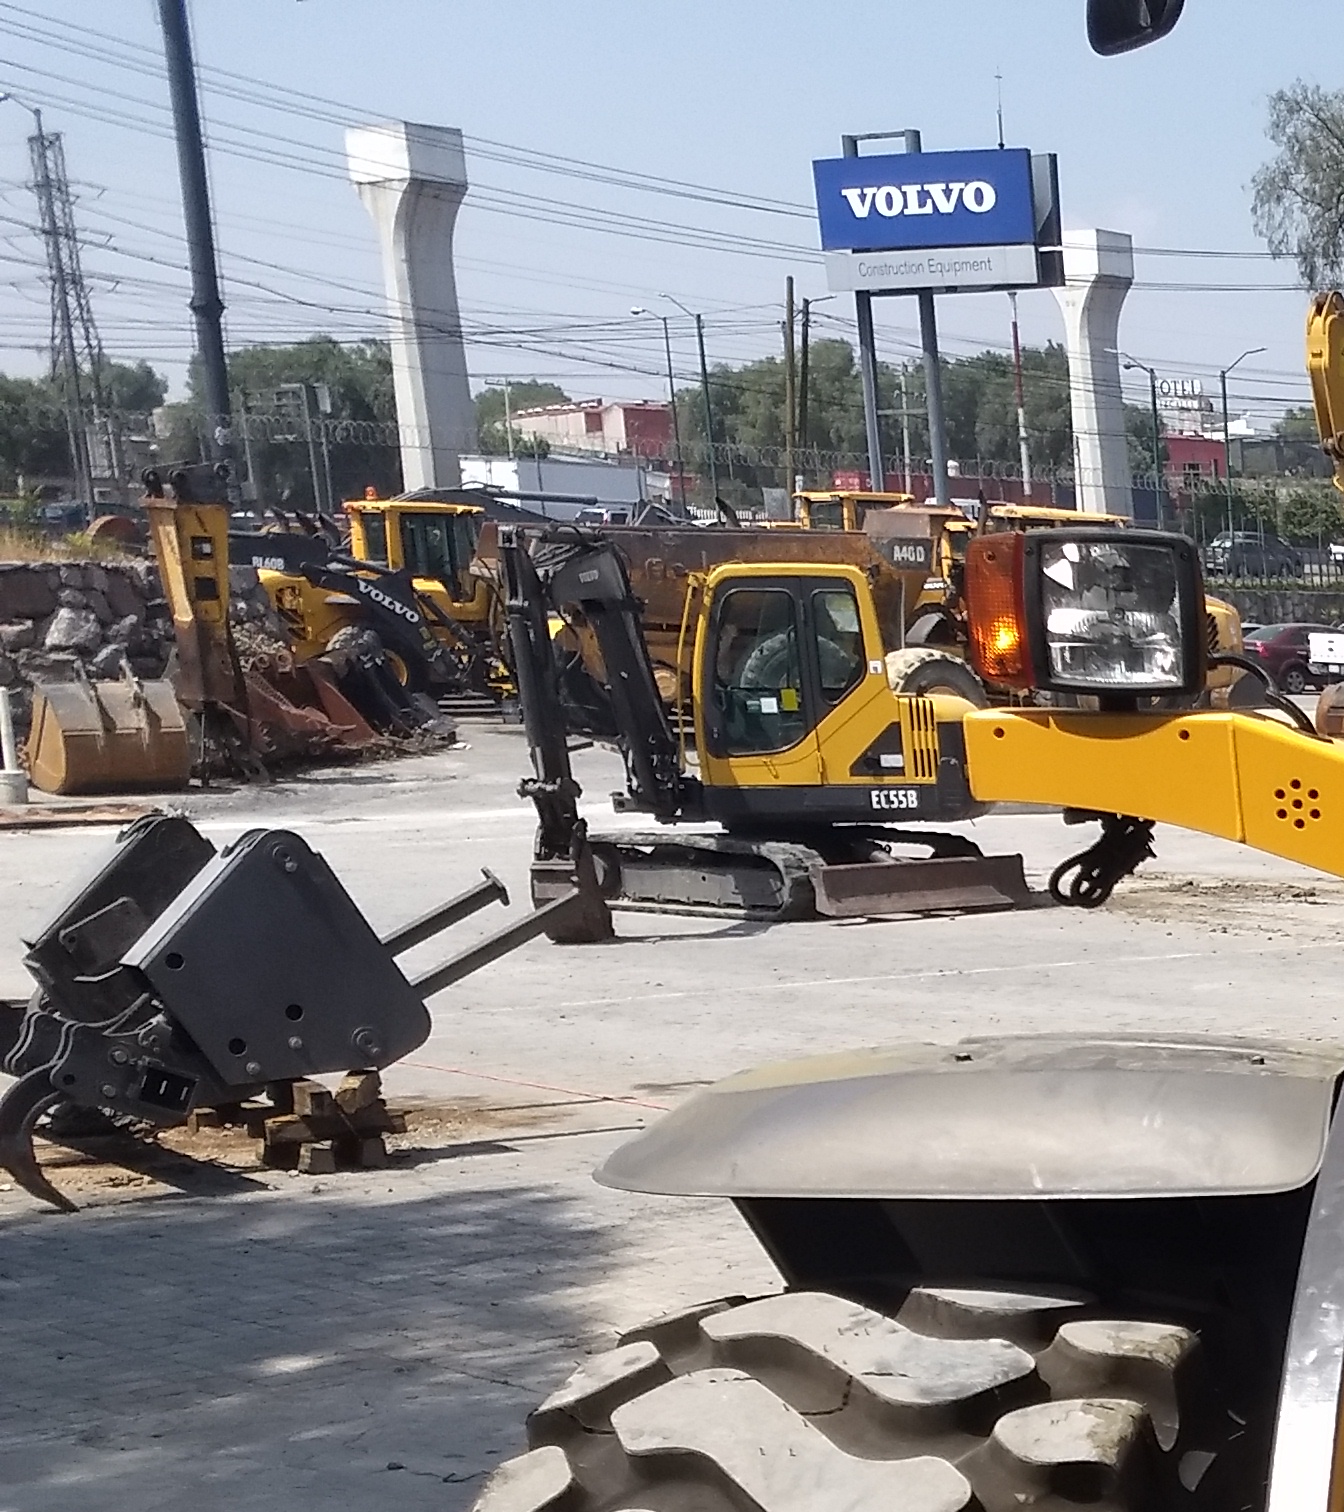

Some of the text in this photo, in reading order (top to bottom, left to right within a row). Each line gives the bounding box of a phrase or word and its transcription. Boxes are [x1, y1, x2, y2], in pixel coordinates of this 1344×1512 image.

[841, 181, 996, 218] VOLVO
[858, 256, 993, 277] Construction Equipment
[1156, 379, 1202, 397] OTEL
[357, 579, 420, 623] VOLVO
[870, 790, 918, 809] EC55B
